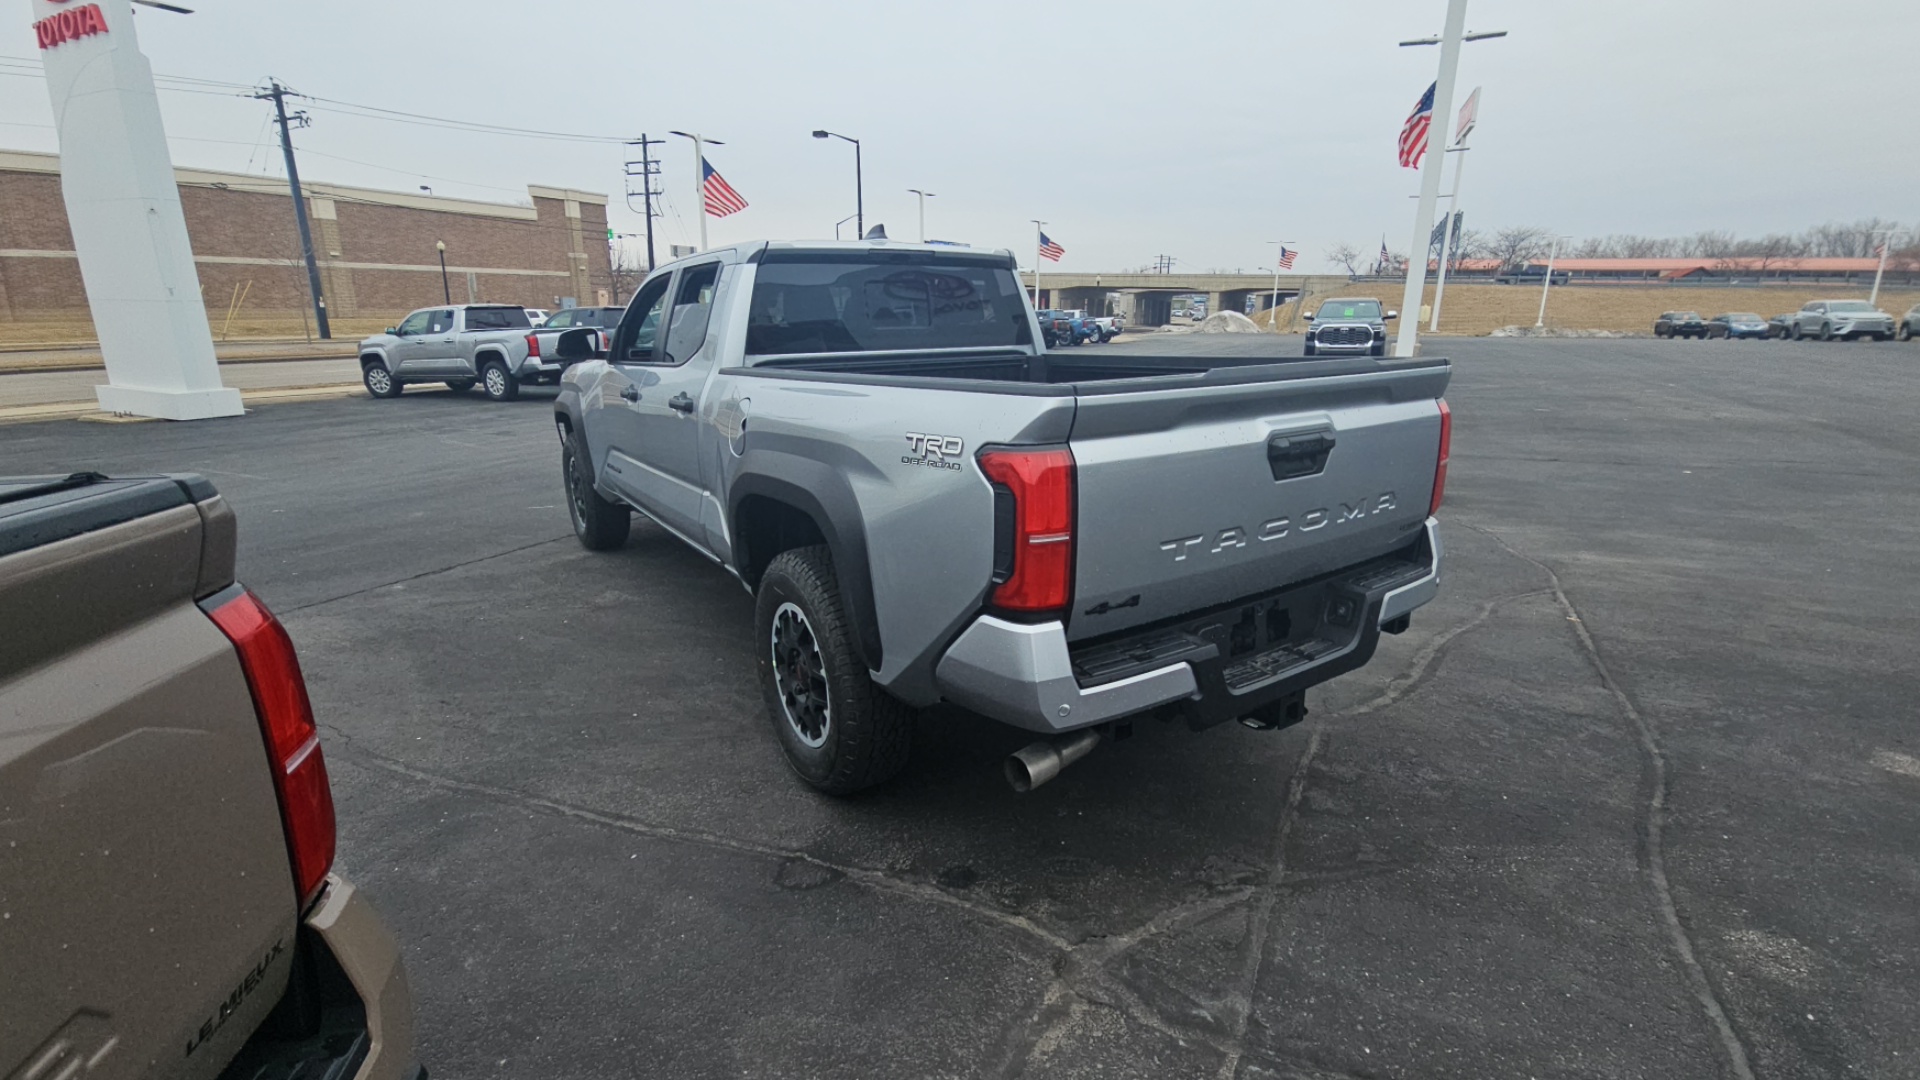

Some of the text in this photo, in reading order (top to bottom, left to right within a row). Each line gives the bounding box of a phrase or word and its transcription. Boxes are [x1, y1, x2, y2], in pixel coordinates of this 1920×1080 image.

[32, 3, 109, 50] TOYOTA
[905, 431, 963, 460] TRD
[1160, 491, 1397, 561] TACOMA
[219, 938, 284, 1022] MIEUX
